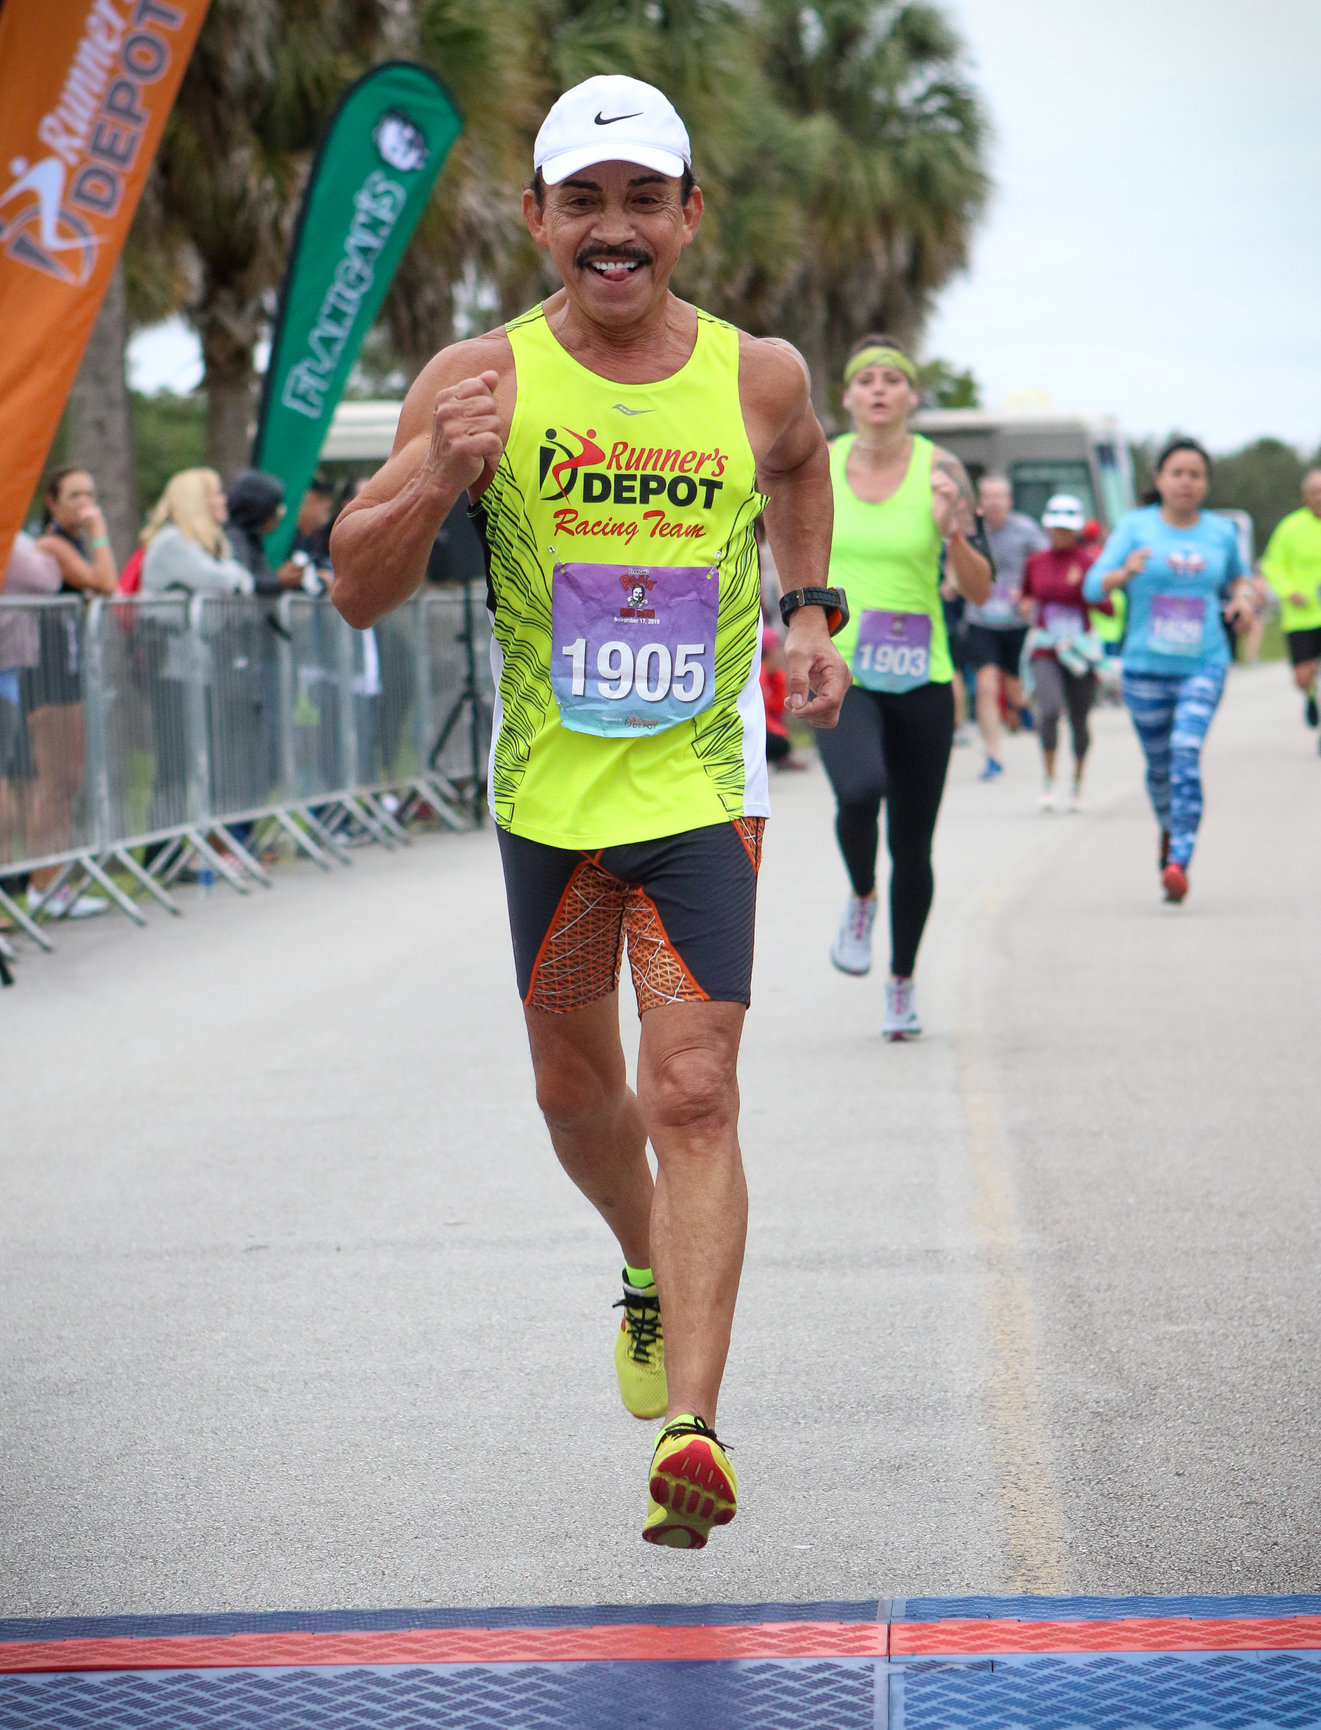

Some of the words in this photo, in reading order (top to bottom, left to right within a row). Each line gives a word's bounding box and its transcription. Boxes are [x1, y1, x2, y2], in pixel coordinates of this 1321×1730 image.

[38, 0, 129, 166] Runner
[70, 0, 186, 219] DEPOT
[606, 441, 729, 477] Runner's
[583, 472, 723, 510] DEPOT
[553, 508, 640, 546] Racing
[643, 510, 707, 538] Team
[613, 616, 639, 624] November
[561, 638, 706, 702] 1905
[859, 643, 927, 677] 1903
